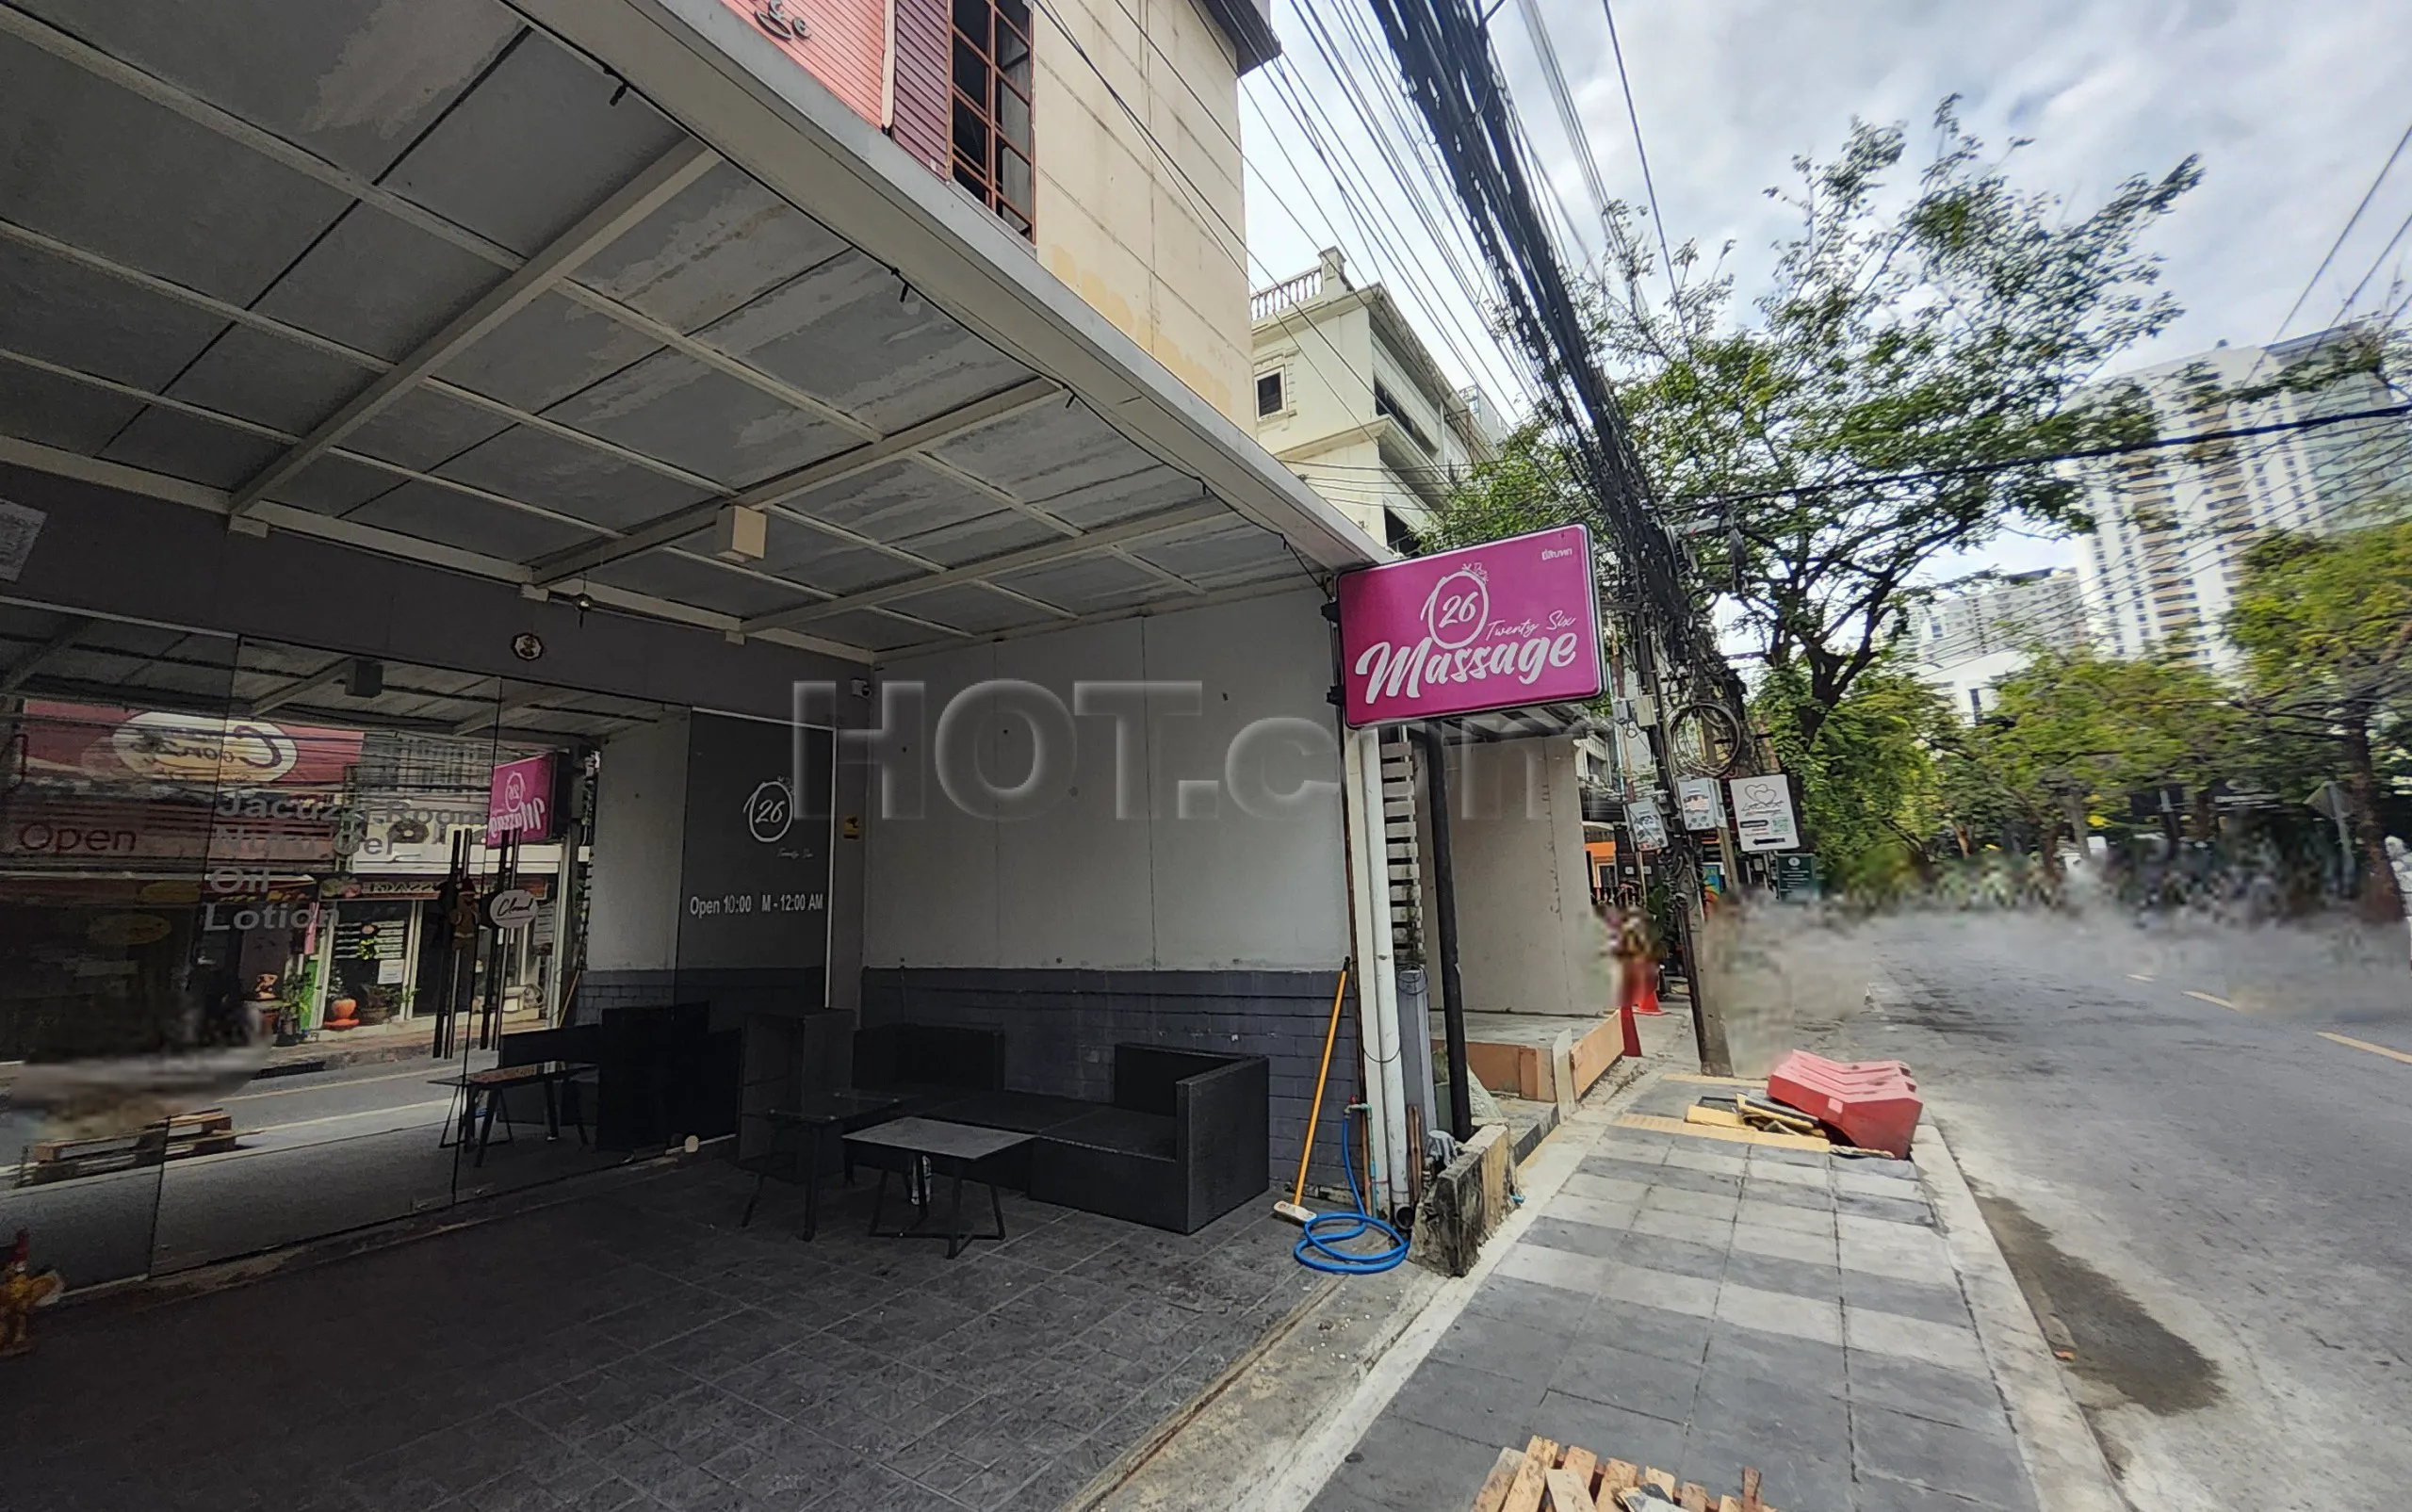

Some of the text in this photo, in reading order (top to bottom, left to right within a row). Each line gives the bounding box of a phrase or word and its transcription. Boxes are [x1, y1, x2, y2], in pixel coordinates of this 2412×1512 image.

[1439, 591, 1478, 628] 26
[1485, 610, 1577, 641] Twenty Six
[1354, 632, 1578, 705] Massage
[755, 799, 786, 824] 26
[19, 821, 137, 854] Open
[209, 866, 269, 894] Oil
[203, 902, 340, 933] Lotion
[690, 896, 720, 919] Open
[723, 895, 752, 915] 10:00
[780, 894, 806, 911] 12:00
[807, 893, 823, 911] AM
